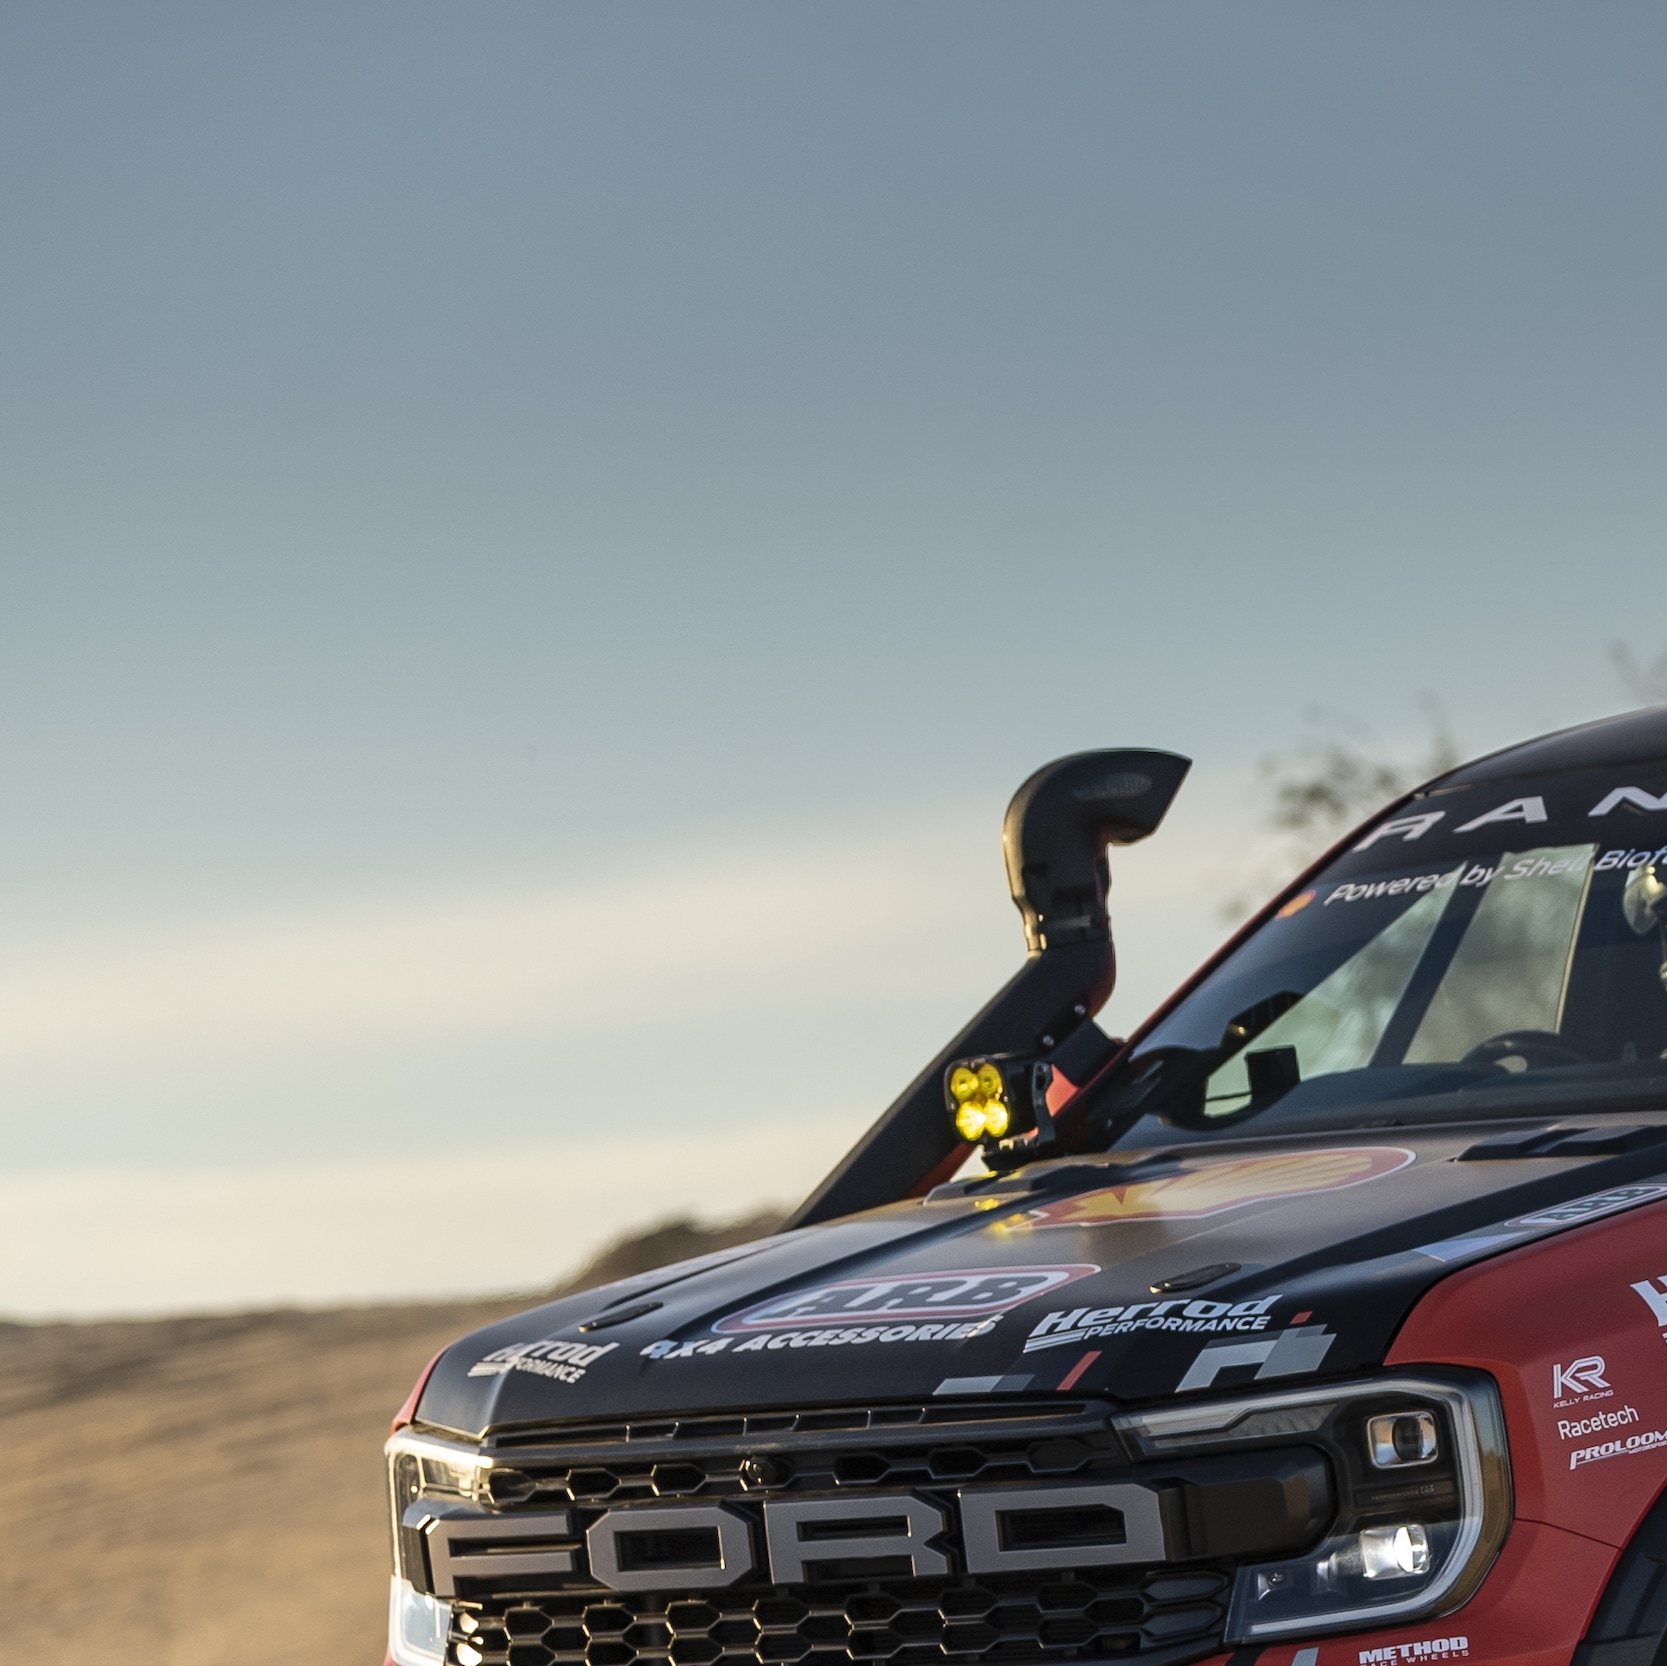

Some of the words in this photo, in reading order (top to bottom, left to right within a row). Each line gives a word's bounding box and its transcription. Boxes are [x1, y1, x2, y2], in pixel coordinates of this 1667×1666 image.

[1323, 862, 1467, 906] Powered
[1460, 864, 1504, 888] by
[1503, 853, 1595, 880] Shell
[753, 1274, 1050, 1322] ARB
[1028, 1294, 1283, 1338] Herrod
[732, 1315, 1004, 1352] ACCESSORIES
[1083, 1315, 1272, 1340] PERFORMANCE
[1552, 1355, 1612, 1399] KR
[1553, 1397, 1581, 1408] KELLY
[1582, 1389, 1614, 1402] RACING
[1557, 1405, 1640, 1440] Racetech
[418, 1483, 1168, 1598] FORD
[1359, 1636, 1469, 1665] METHOD
[1406, 1650, 1470, 1664] WHEELS
